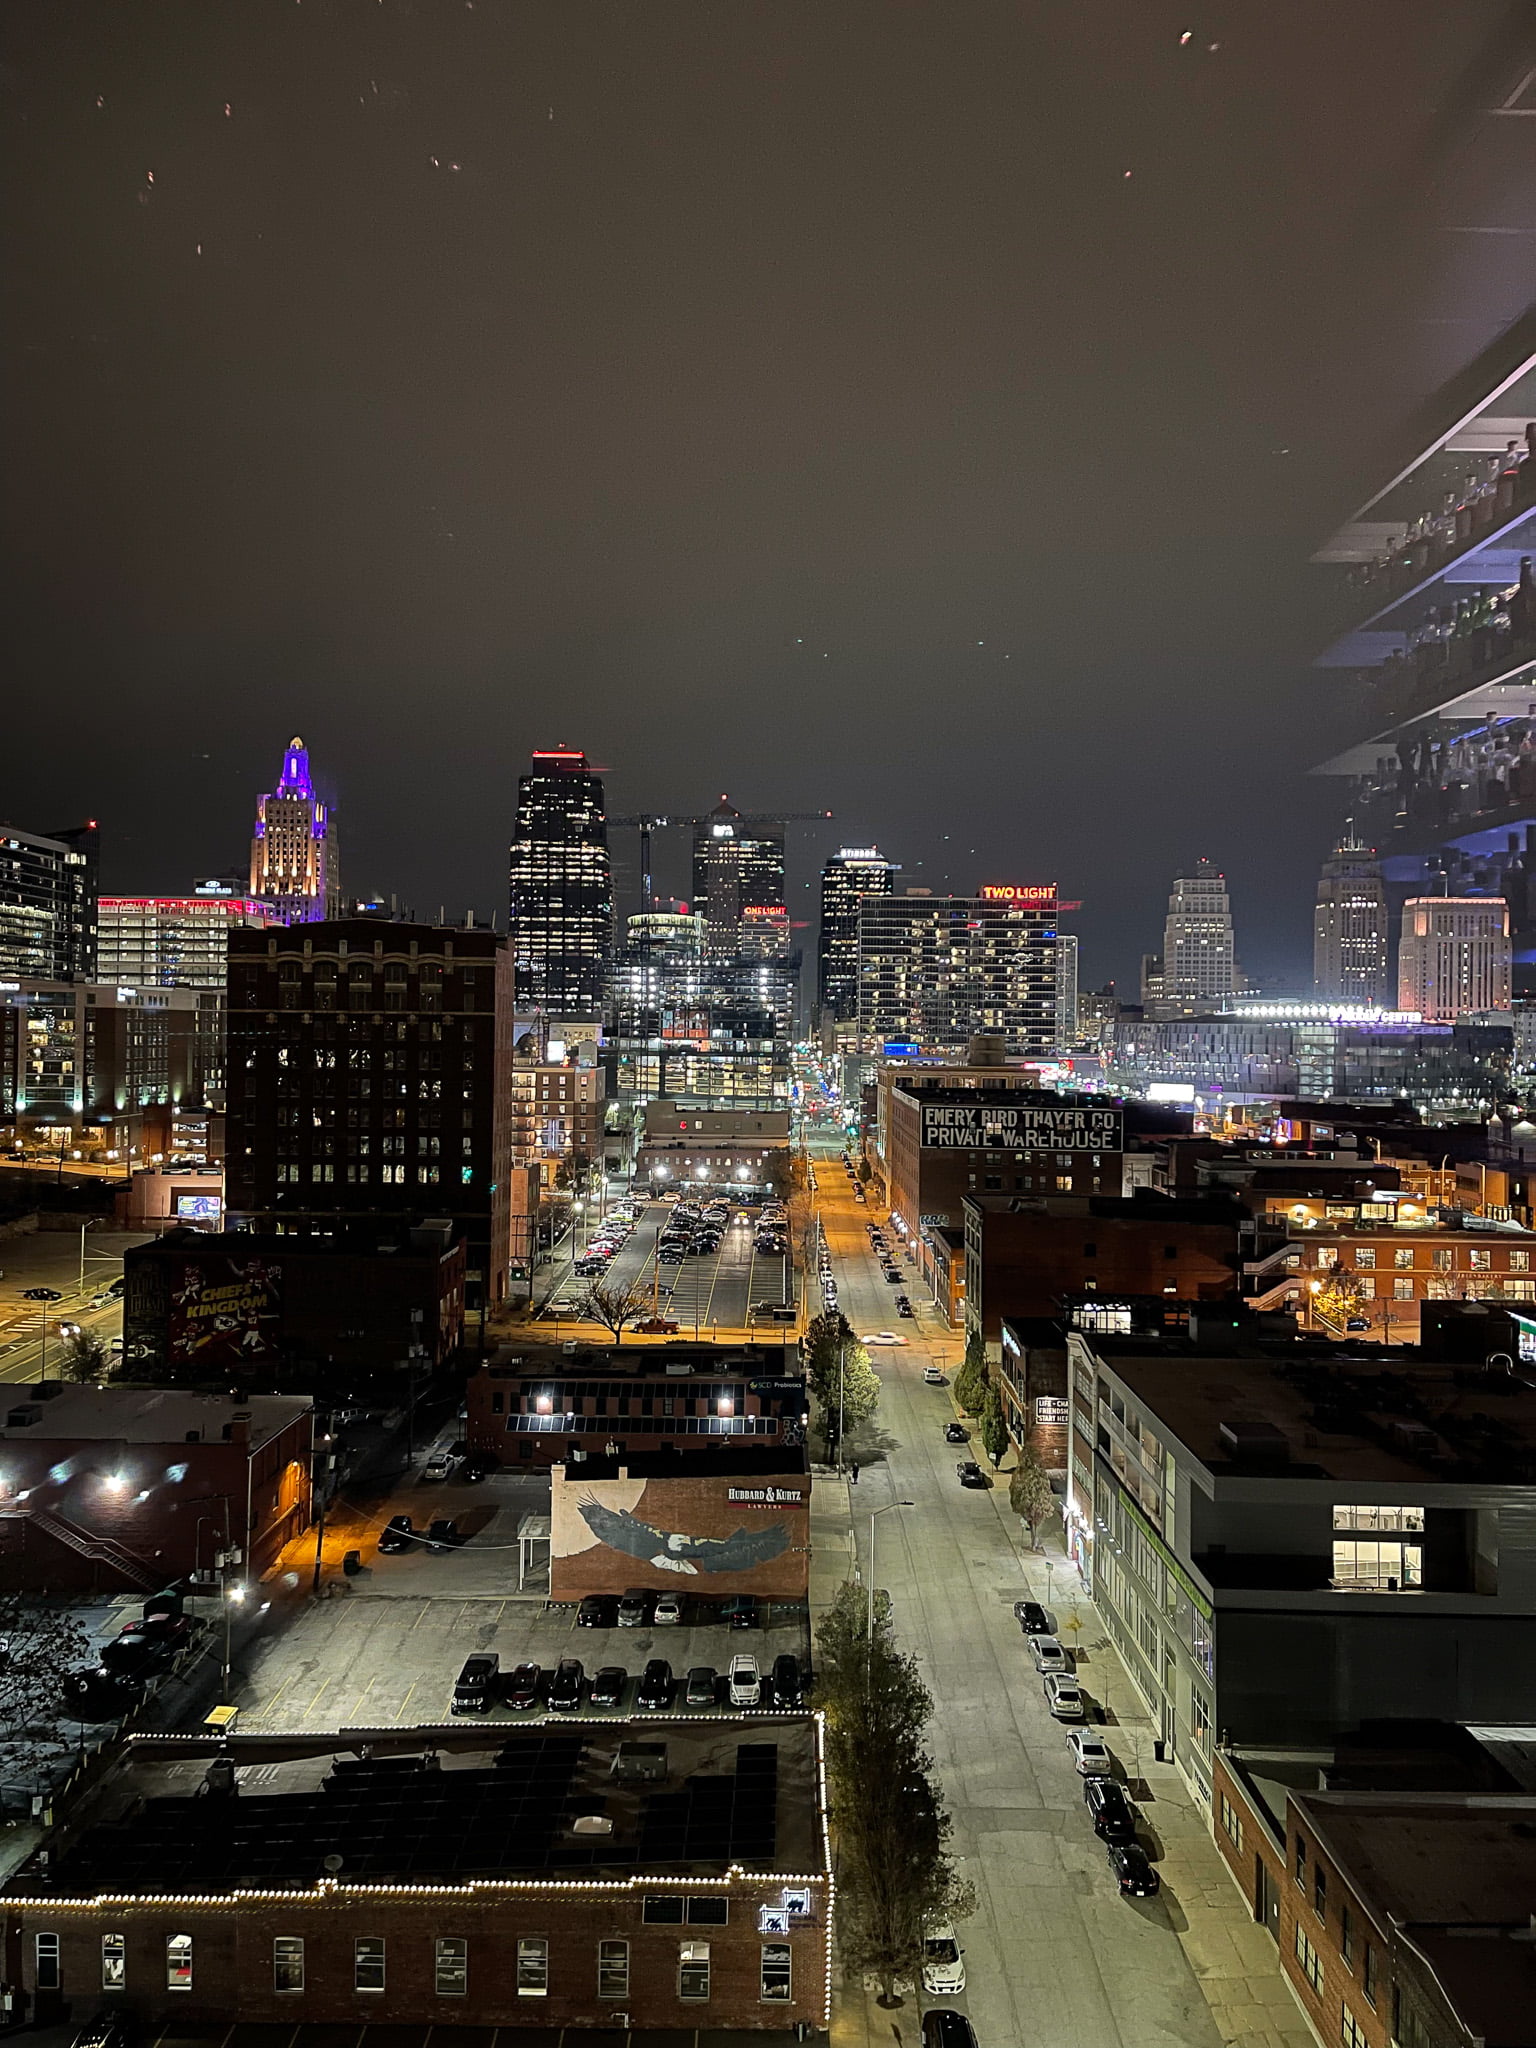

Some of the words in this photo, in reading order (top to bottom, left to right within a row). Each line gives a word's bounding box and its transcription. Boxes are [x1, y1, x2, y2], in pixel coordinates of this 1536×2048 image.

[984, 886, 1015, 899] TWO
[1016, 887, 1055, 899] LIGHT
[743, 906, 762, 915] ONE
[762, 906, 786, 915] LIGHT
[925, 1108, 976, 1126] EMERY
[981, 1110, 1018, 1127] BIRD
[1023, 1110, 1085, 1129] THAYER
[927, 1127, 993, 1146] PRIVATE
[1001, 1129, 1113, 1149] WAREHOUSE
[200, 1283, 252, 1302] CHIEFS
[186, 1294, 268, 1319] KINGDOM
[728, 1488, 765, 1500] HUBBARD
[765, 1486, 775, 1502] &
[776, 1489, 802, 1501] KURTZ
